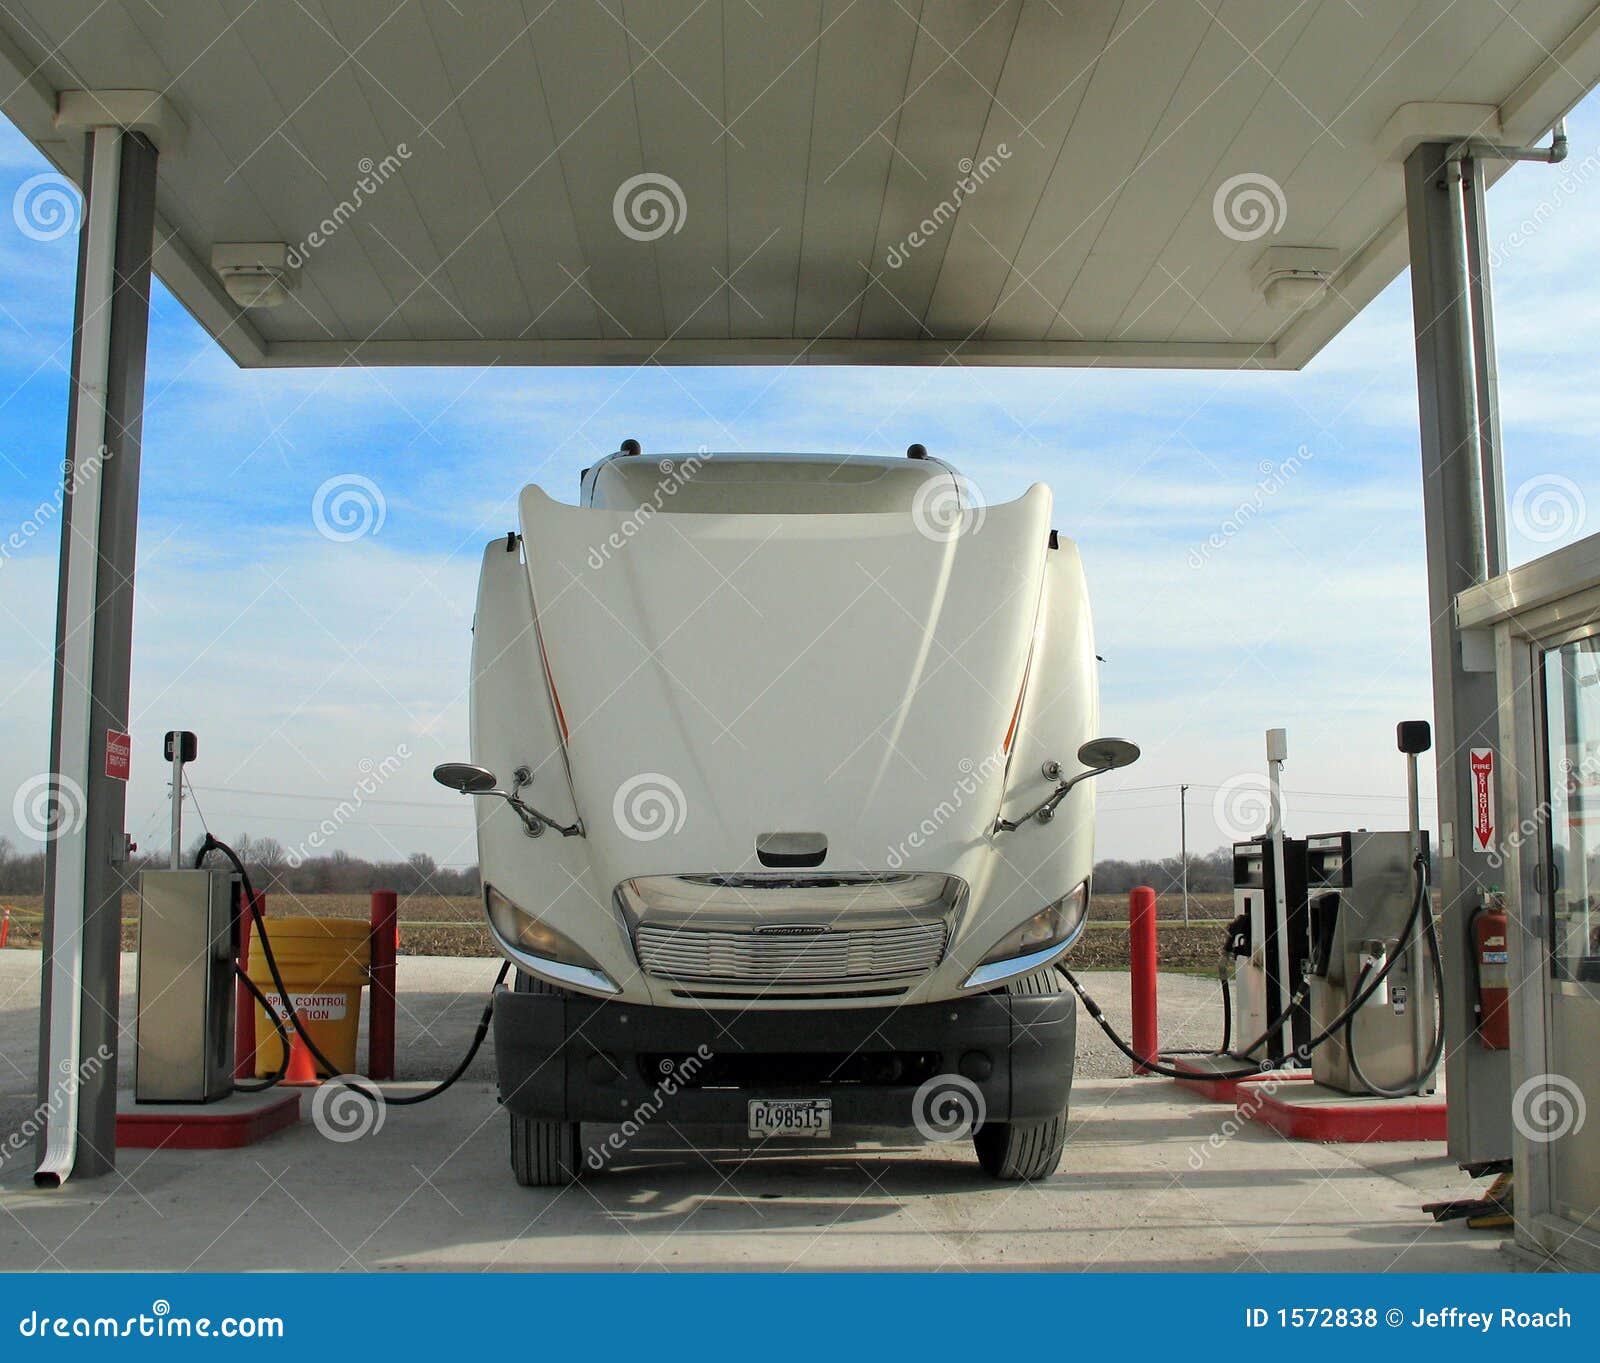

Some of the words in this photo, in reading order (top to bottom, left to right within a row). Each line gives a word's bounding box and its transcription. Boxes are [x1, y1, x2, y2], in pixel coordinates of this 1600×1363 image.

[1479, 773, 1488, 833] EXTINGUISHER
[267, 997, 288, 1006] SPI
[296, 997, 344, 1006] CONTROL
[281, 1010, 329, 1019] SION
[755, 1108, 822, 1128] P498515
